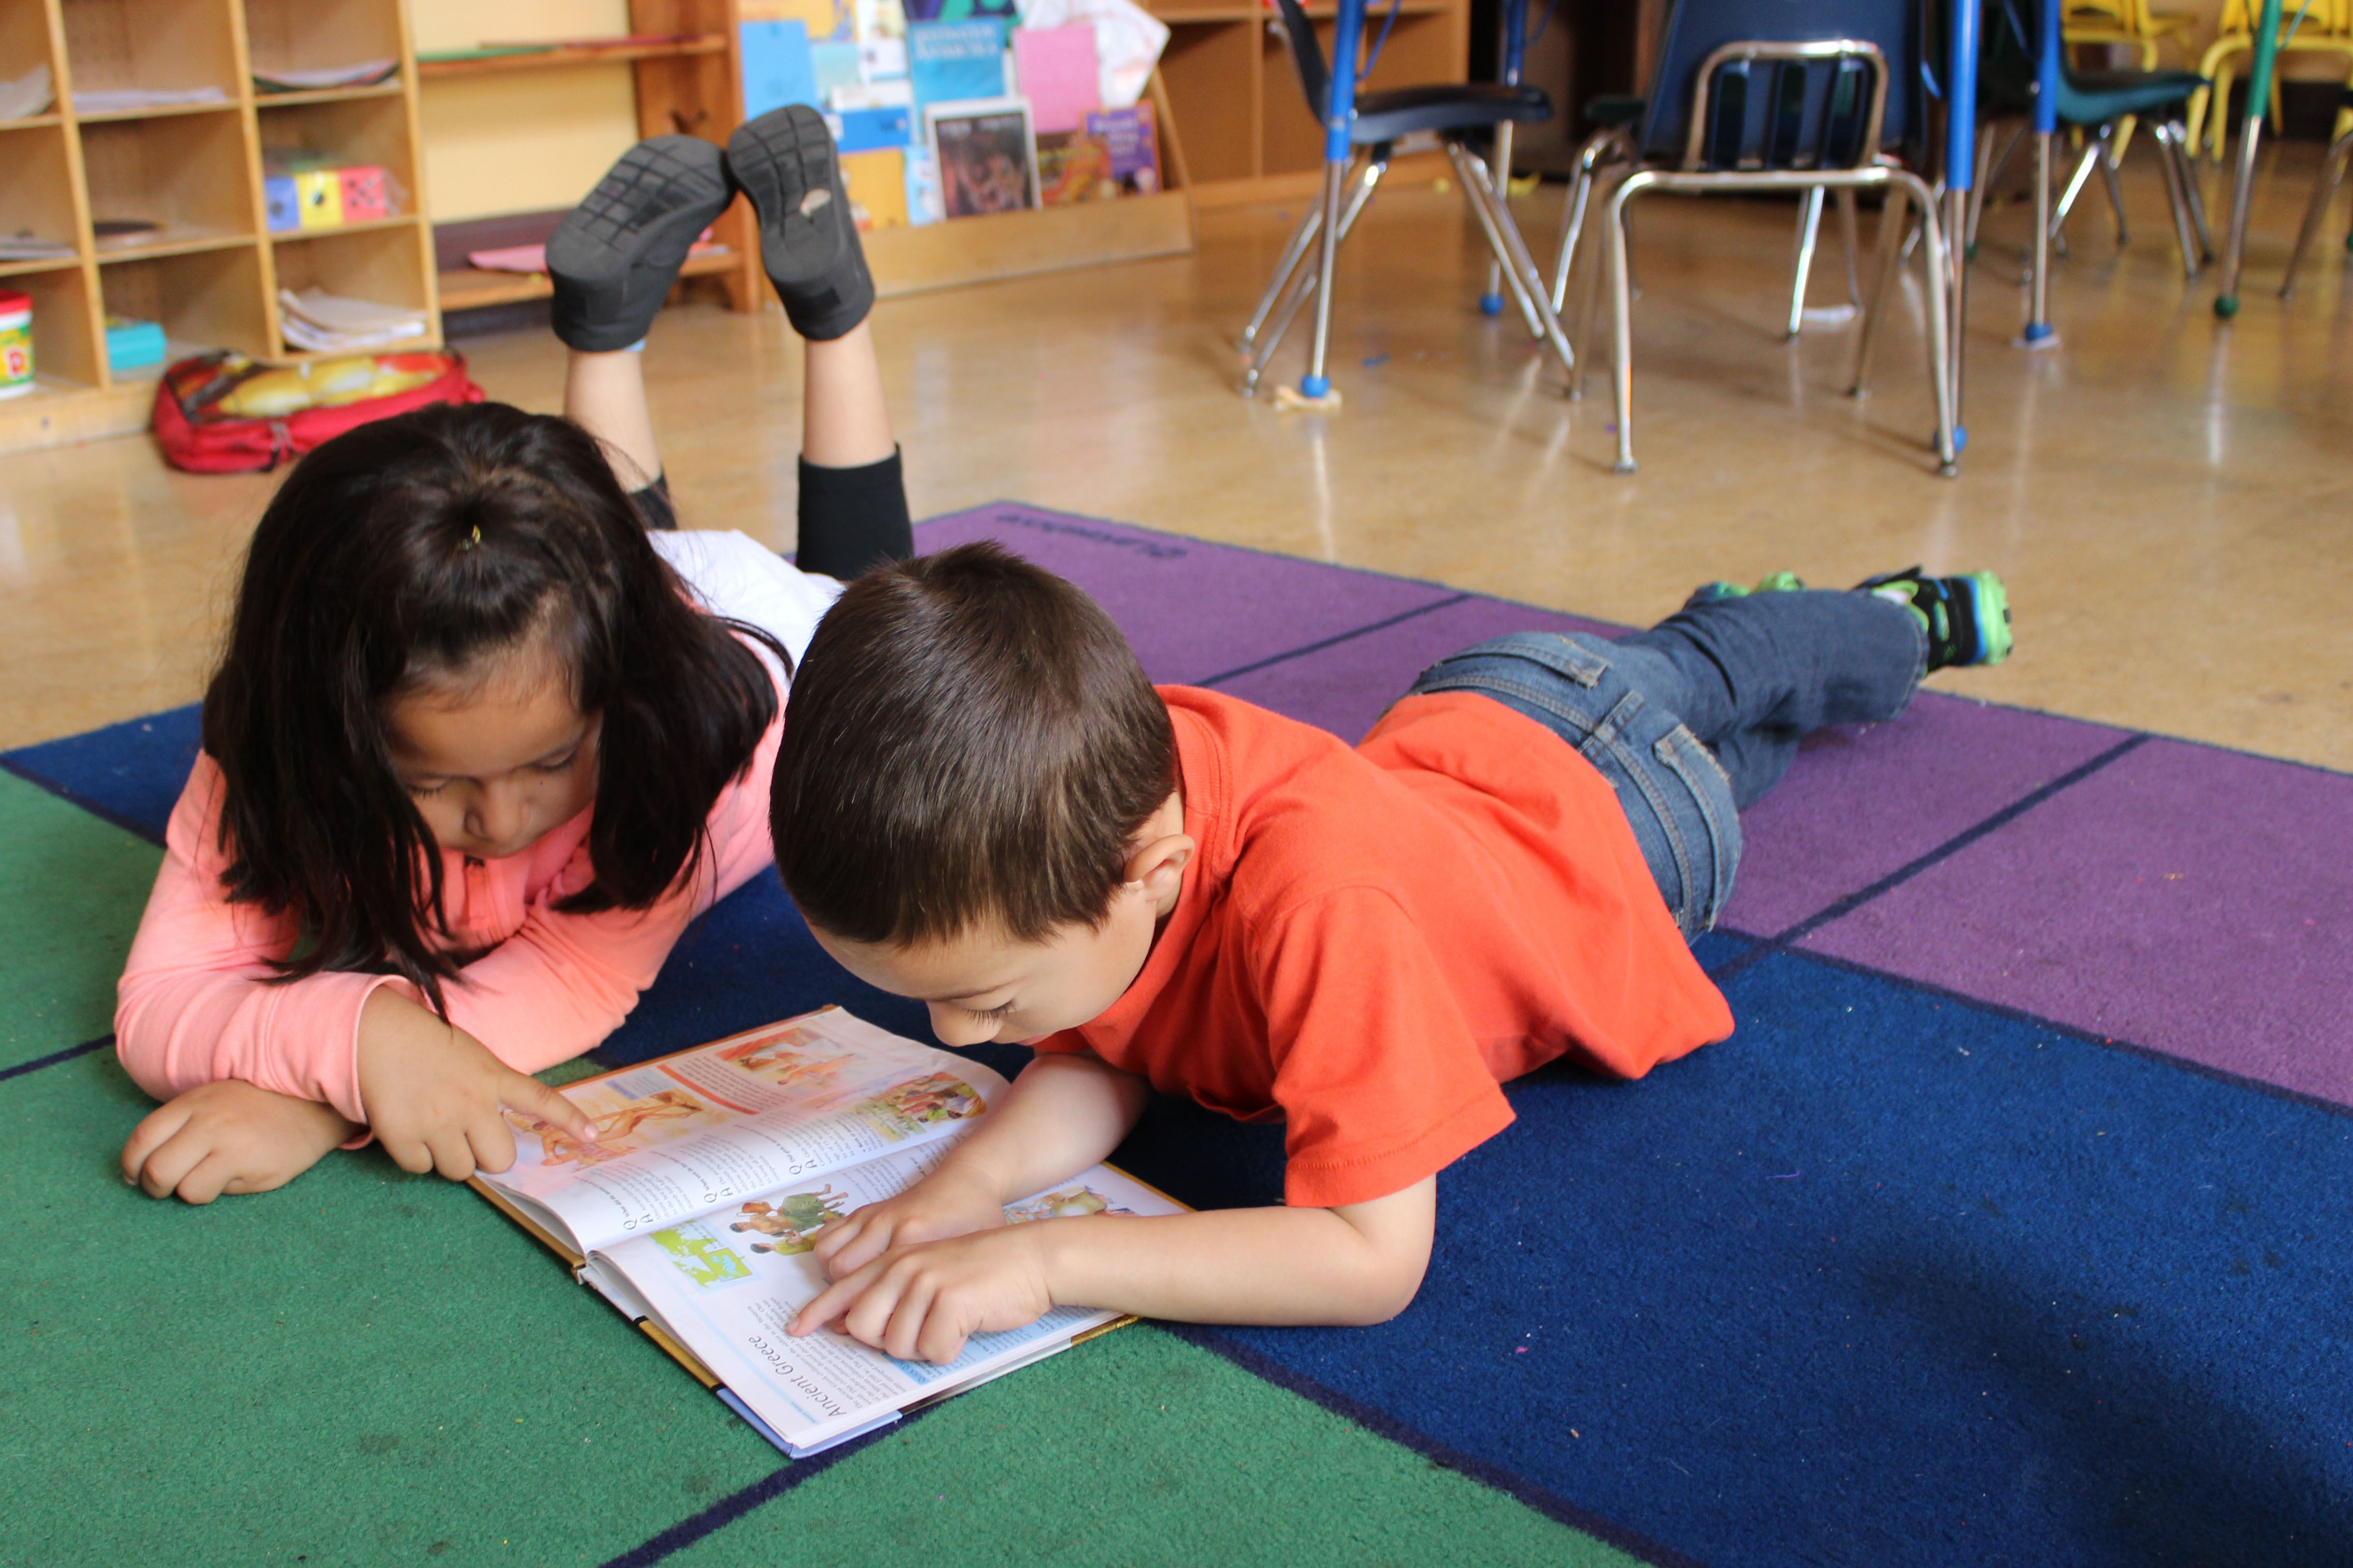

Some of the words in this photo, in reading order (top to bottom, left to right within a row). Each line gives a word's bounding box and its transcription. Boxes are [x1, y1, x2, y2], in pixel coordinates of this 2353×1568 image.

[801, 1159, 818, 1168] A
[789, 1164, 803, 1175] Q
[720, 1186, 733, 1196] A
[704, 1192, 718, 1203] Q
[640, 1213, 654, 1223] A
[623, 1219, 638, 1230] Q
[748, 1336, 794, 1375] Greece
[790, 1375, 847, 1417] Ancient
